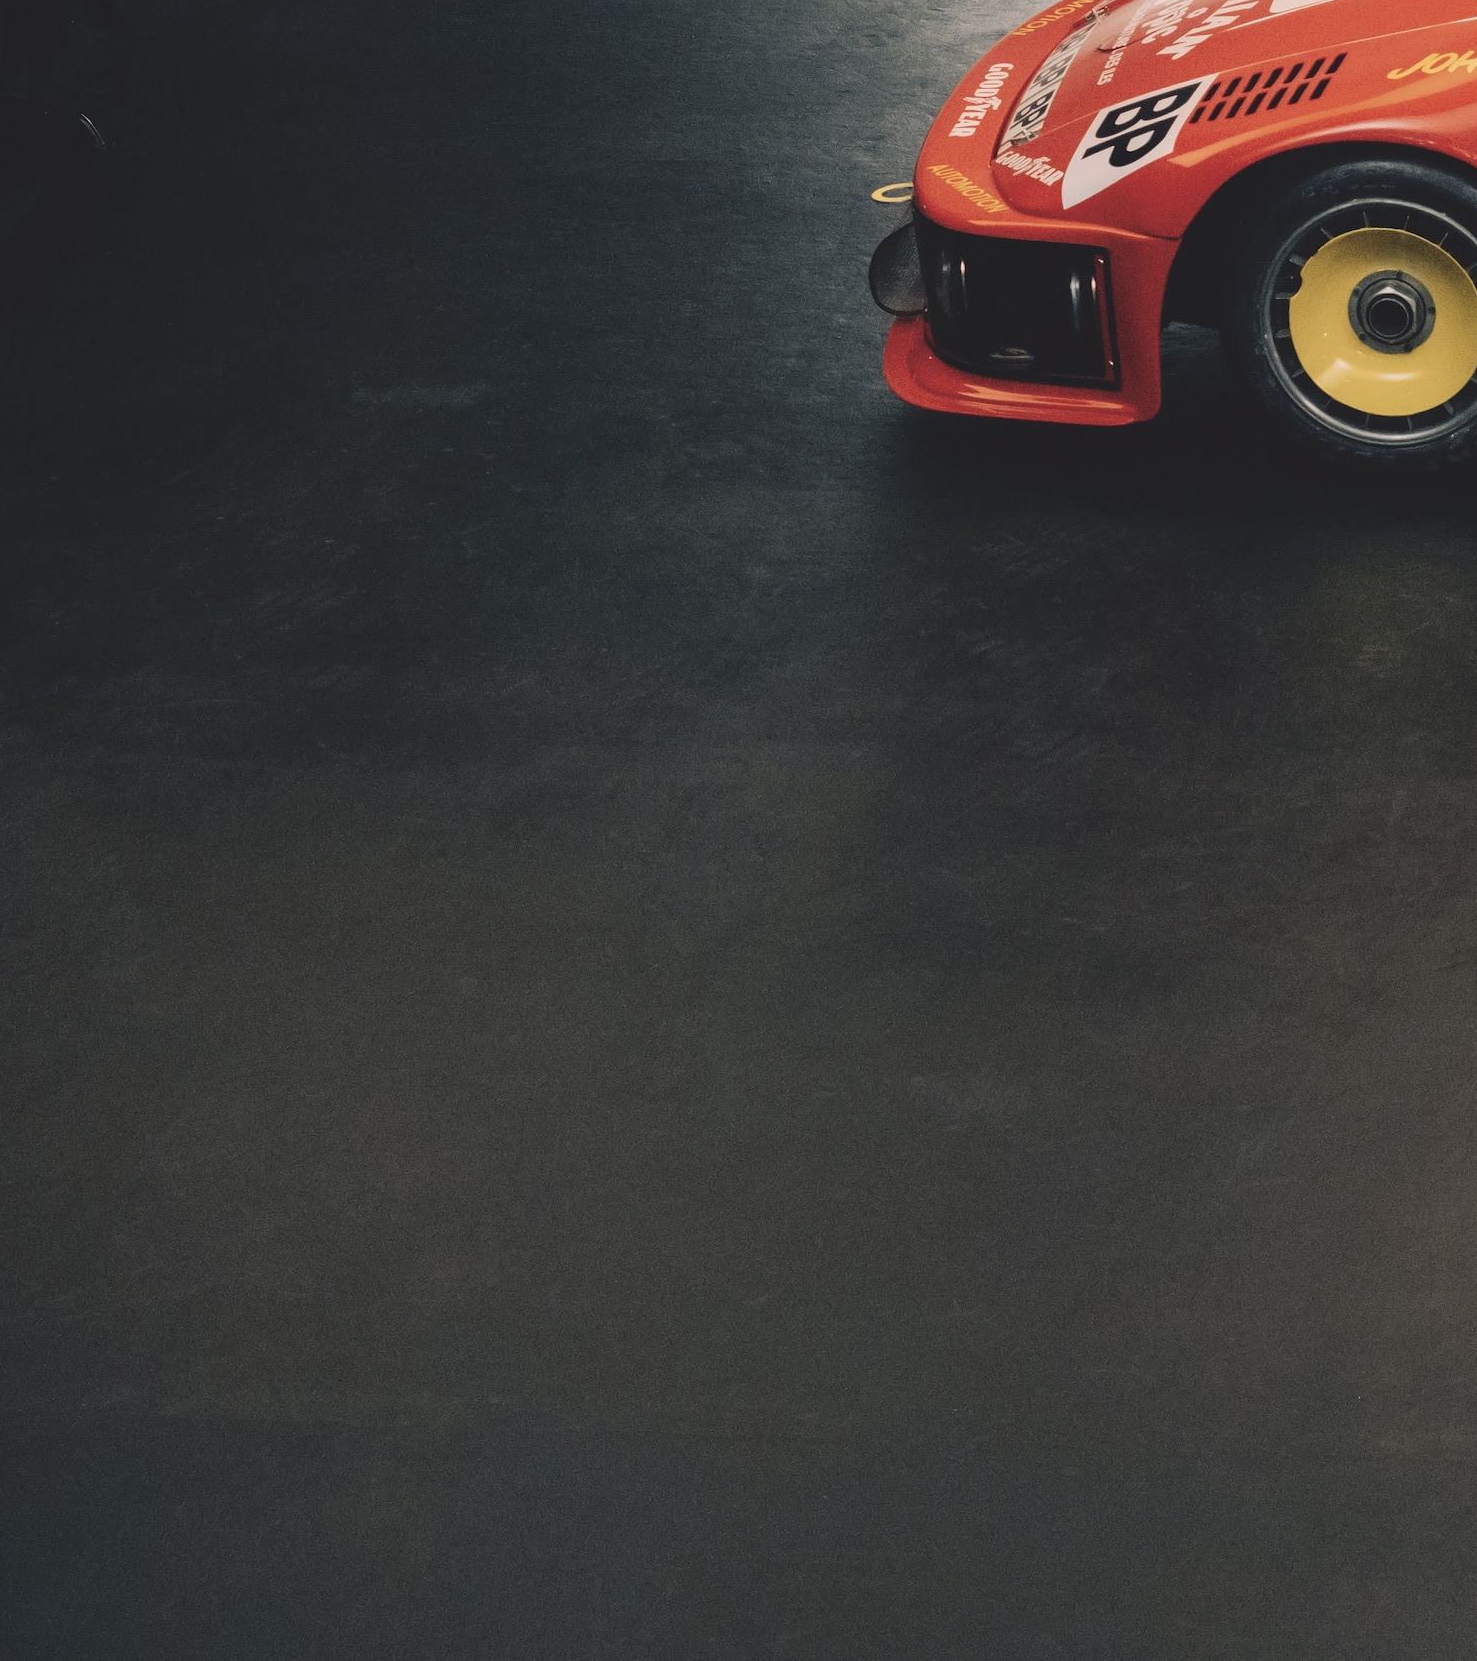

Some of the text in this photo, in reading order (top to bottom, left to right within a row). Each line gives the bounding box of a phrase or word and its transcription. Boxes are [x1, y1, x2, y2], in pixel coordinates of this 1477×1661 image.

[948, 62, 1014, 138] GOODYEAR
[1081, 80, 1204, 167] BP
[927, 164, 1007, 215] AUTOMOTION
[997, 147, 1064, 187] GOODYEAR
